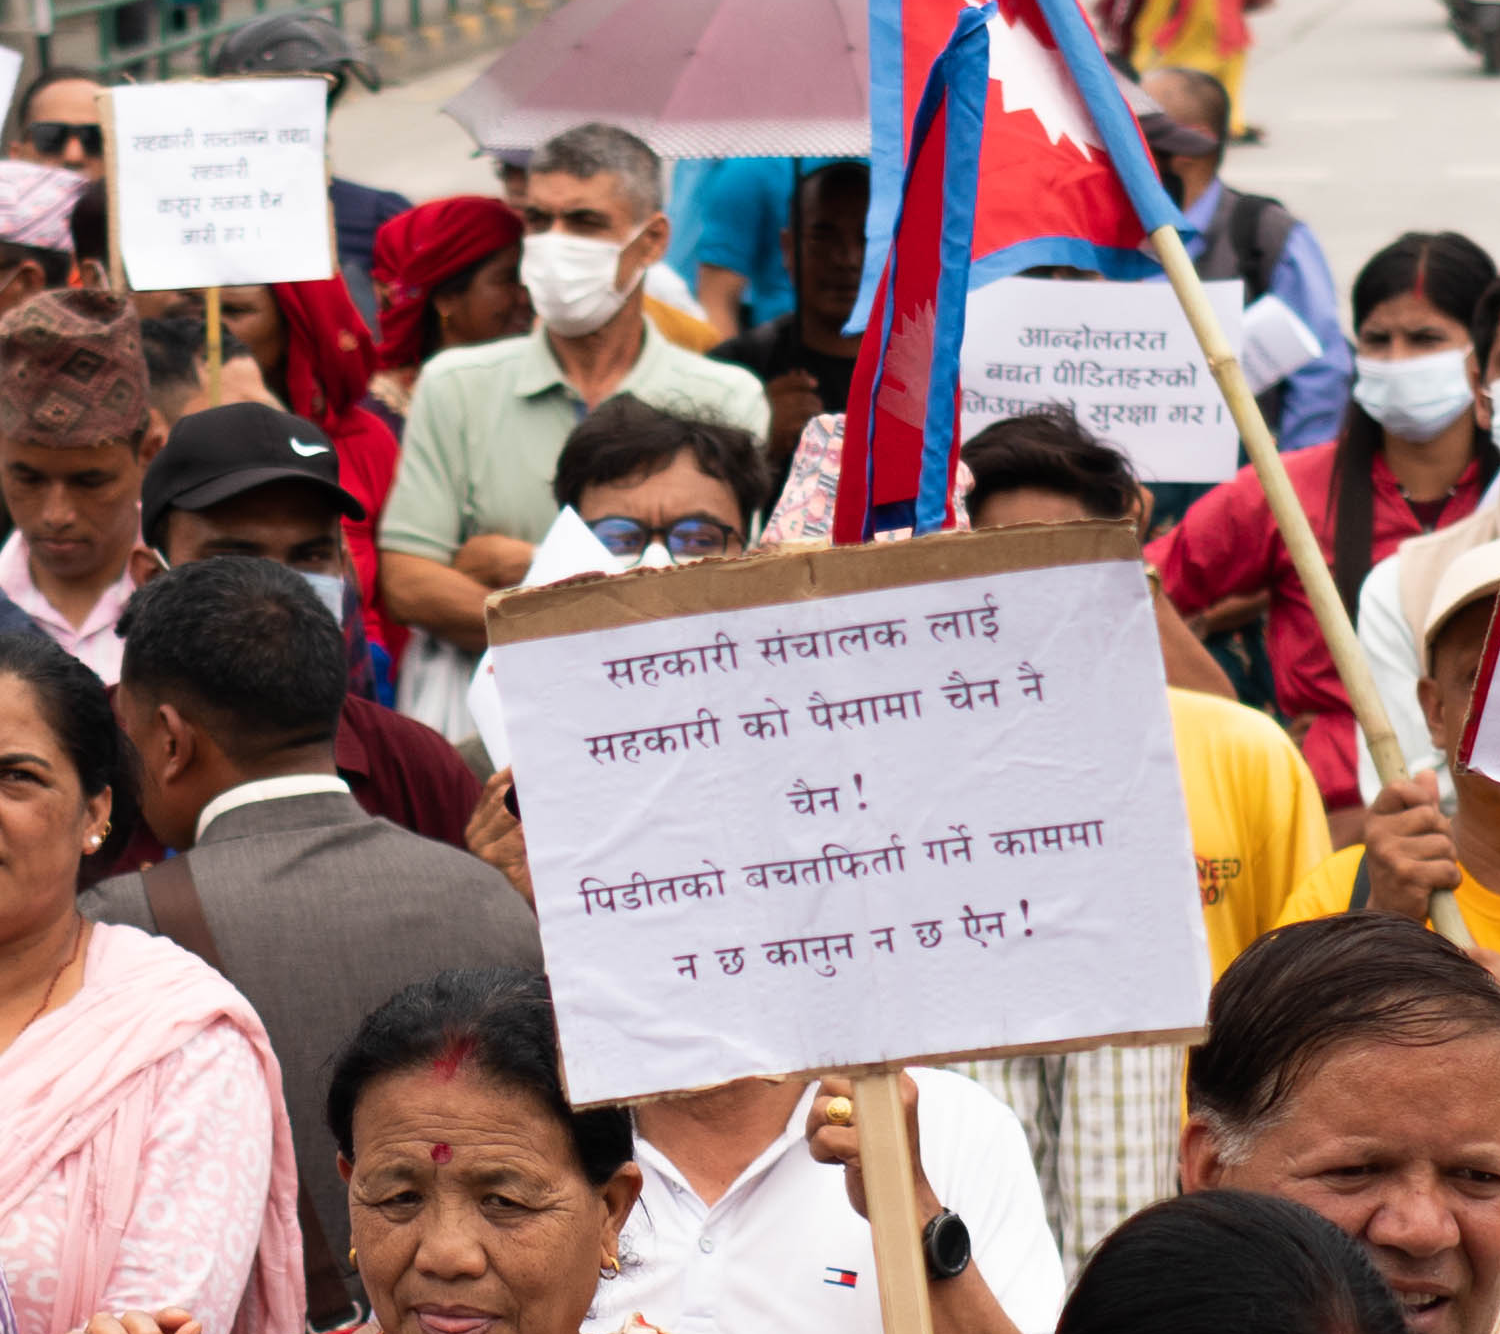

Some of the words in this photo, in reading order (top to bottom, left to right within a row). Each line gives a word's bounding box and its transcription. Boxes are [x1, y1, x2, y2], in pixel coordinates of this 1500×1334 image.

[1018, 324, 1167, 350] आन्दोलतरत
[985, 364, 1042, 384] बचत
[1053, 359, 1198, 389] पीडितहरुको
[1089, 405, 1157, 433] सुरक्षा
[602, 632, 738, 688] सहकारी
[756, 619, 906, 665] संचालक
[925, 593, 999, 643] लाई
[584, 708, 720, 763] सहकारी
[738, 698, 789, 739] को
[807, 690, 922, 731] पैसामा
[940, 671, 1000, 710] चैन
[1018, 661, 1044, 701] नै
[786, 779, 839, 815] चैन
[578, 868, 725, 915] पिडीतको
[741, 834, 905, 889] बचतफिर्ता
[922, 824, 973, 864] गर्ने
[989, 820, 1104, 856] काममा
[672, 954, 698, 979] न
[714, 947, 744, 975] छ
[761, 933, 853, 977] कानुन
[870, 927, 895, 953] न
[911, 920, 942, 948] छ
[959, 905, 1005, 948] ऐन
